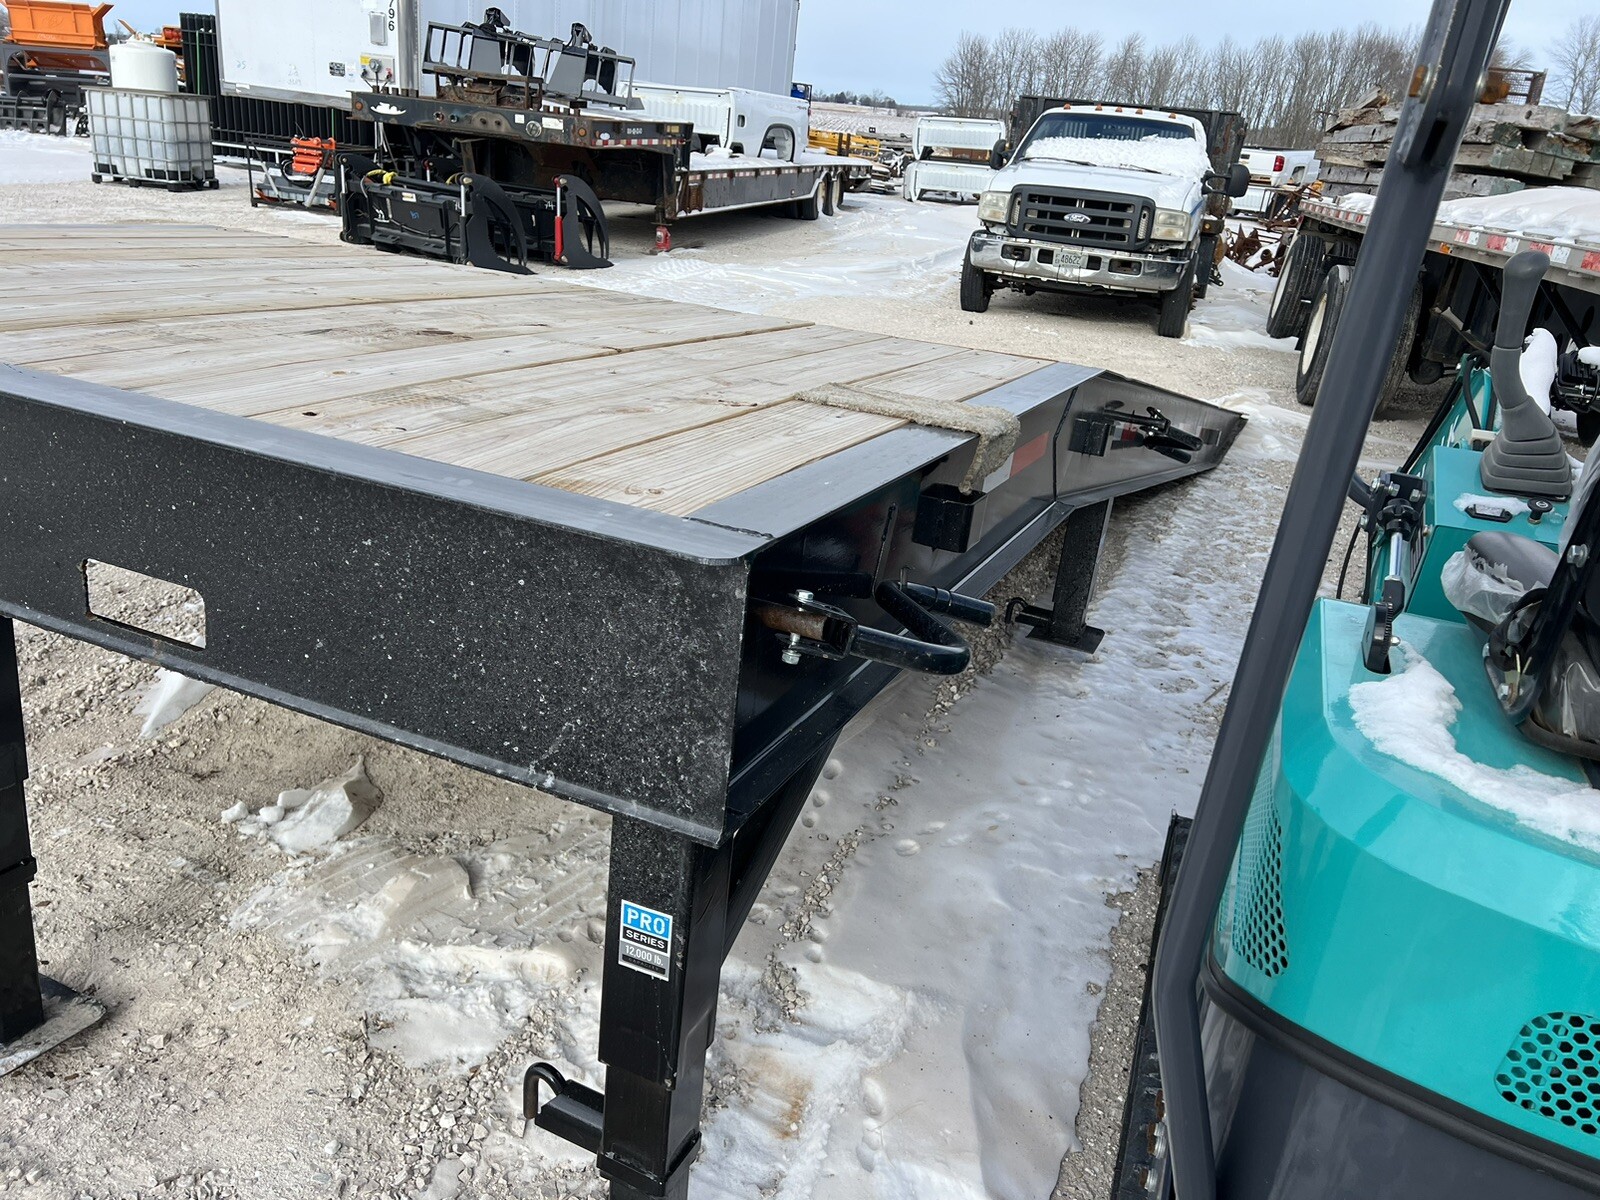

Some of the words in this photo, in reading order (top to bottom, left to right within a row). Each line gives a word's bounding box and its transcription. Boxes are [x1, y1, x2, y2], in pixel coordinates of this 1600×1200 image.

[627, 907, 666, 935] PRO
[626, 929, 665, 949] SERIES
[625, 945, 652, 962] 12,000
